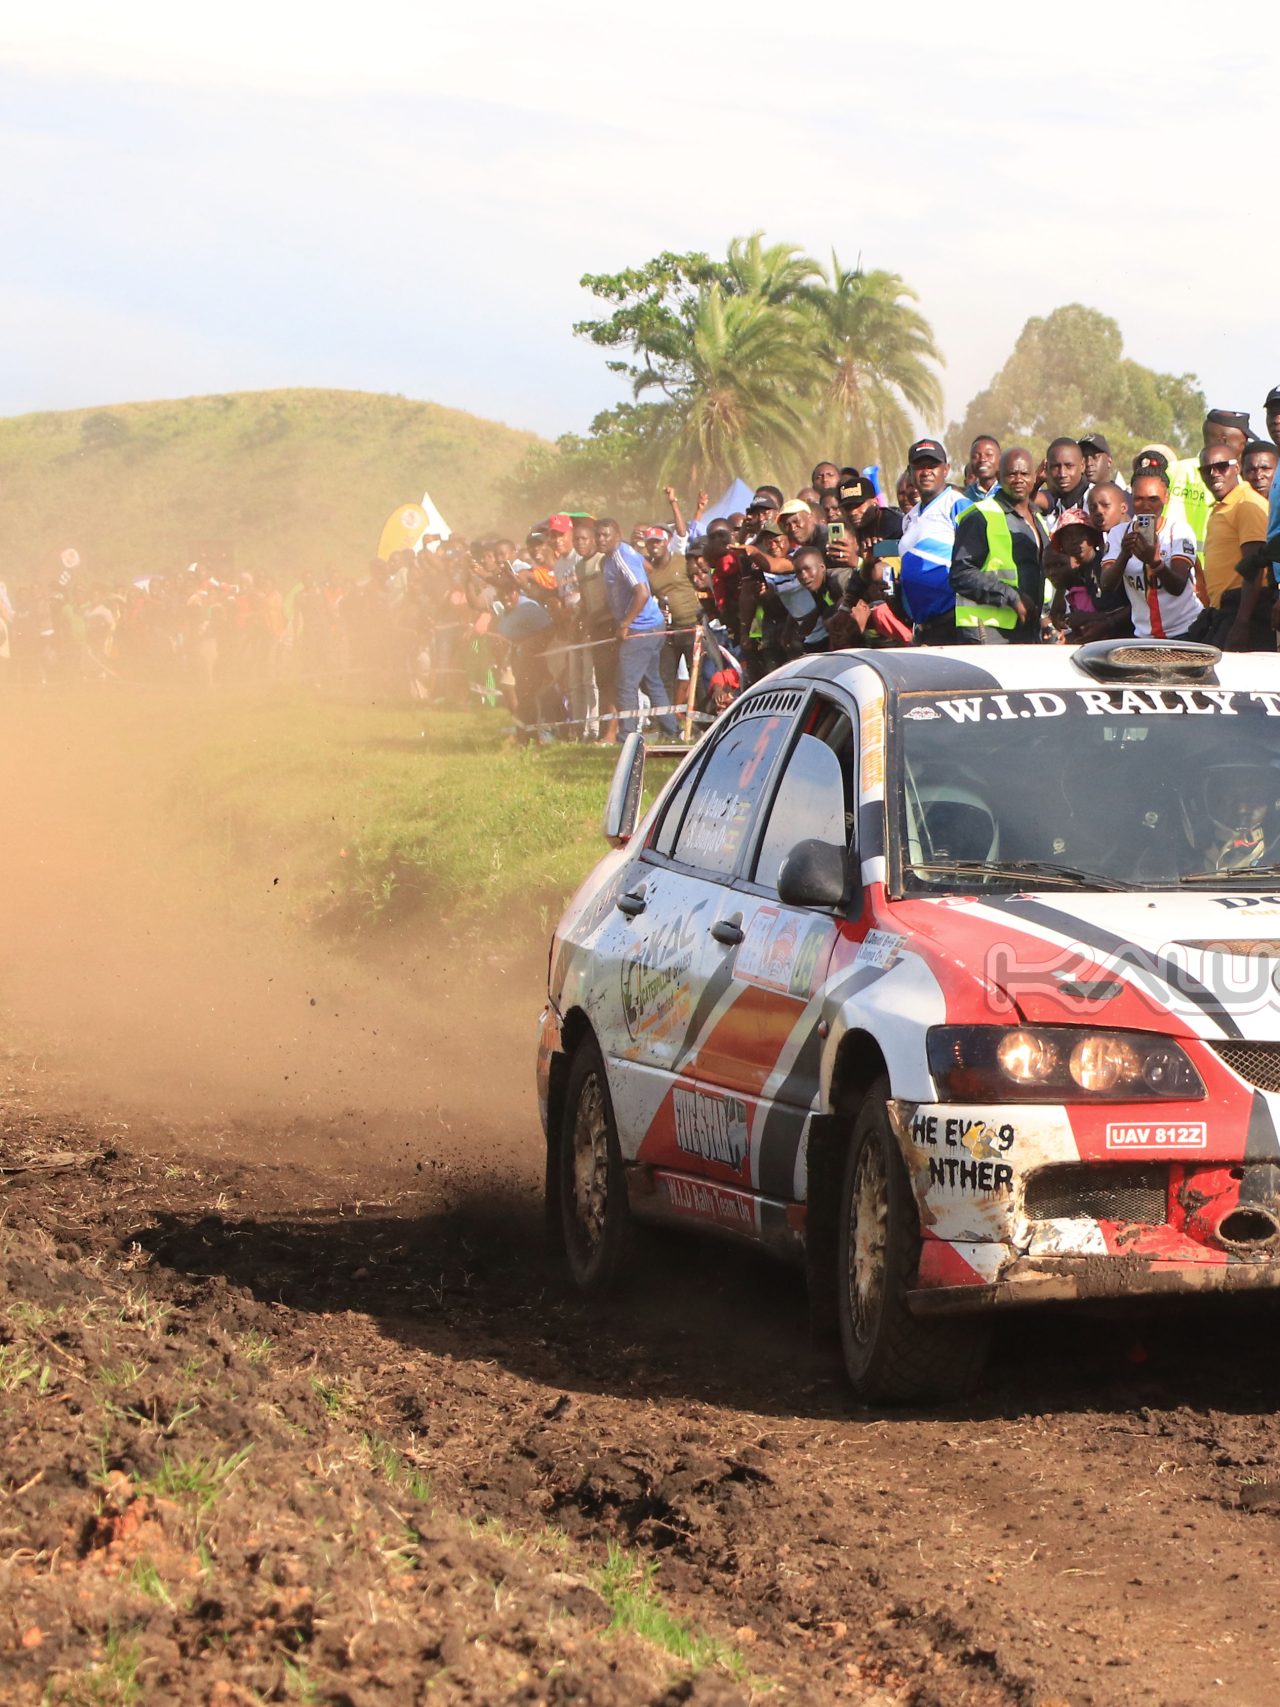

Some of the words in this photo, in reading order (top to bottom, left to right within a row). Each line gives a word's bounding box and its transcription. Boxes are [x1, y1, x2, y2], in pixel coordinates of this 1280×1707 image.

[935, 692, 1067, 723] W.I.D
[1076, 690, 1238, 715] RALLY
[1112, 1128, 1150, 1144] UAV
[1155, 1127, 1202, 1144] 812Z
[929, 1156, 1014, 1194] NTHER
